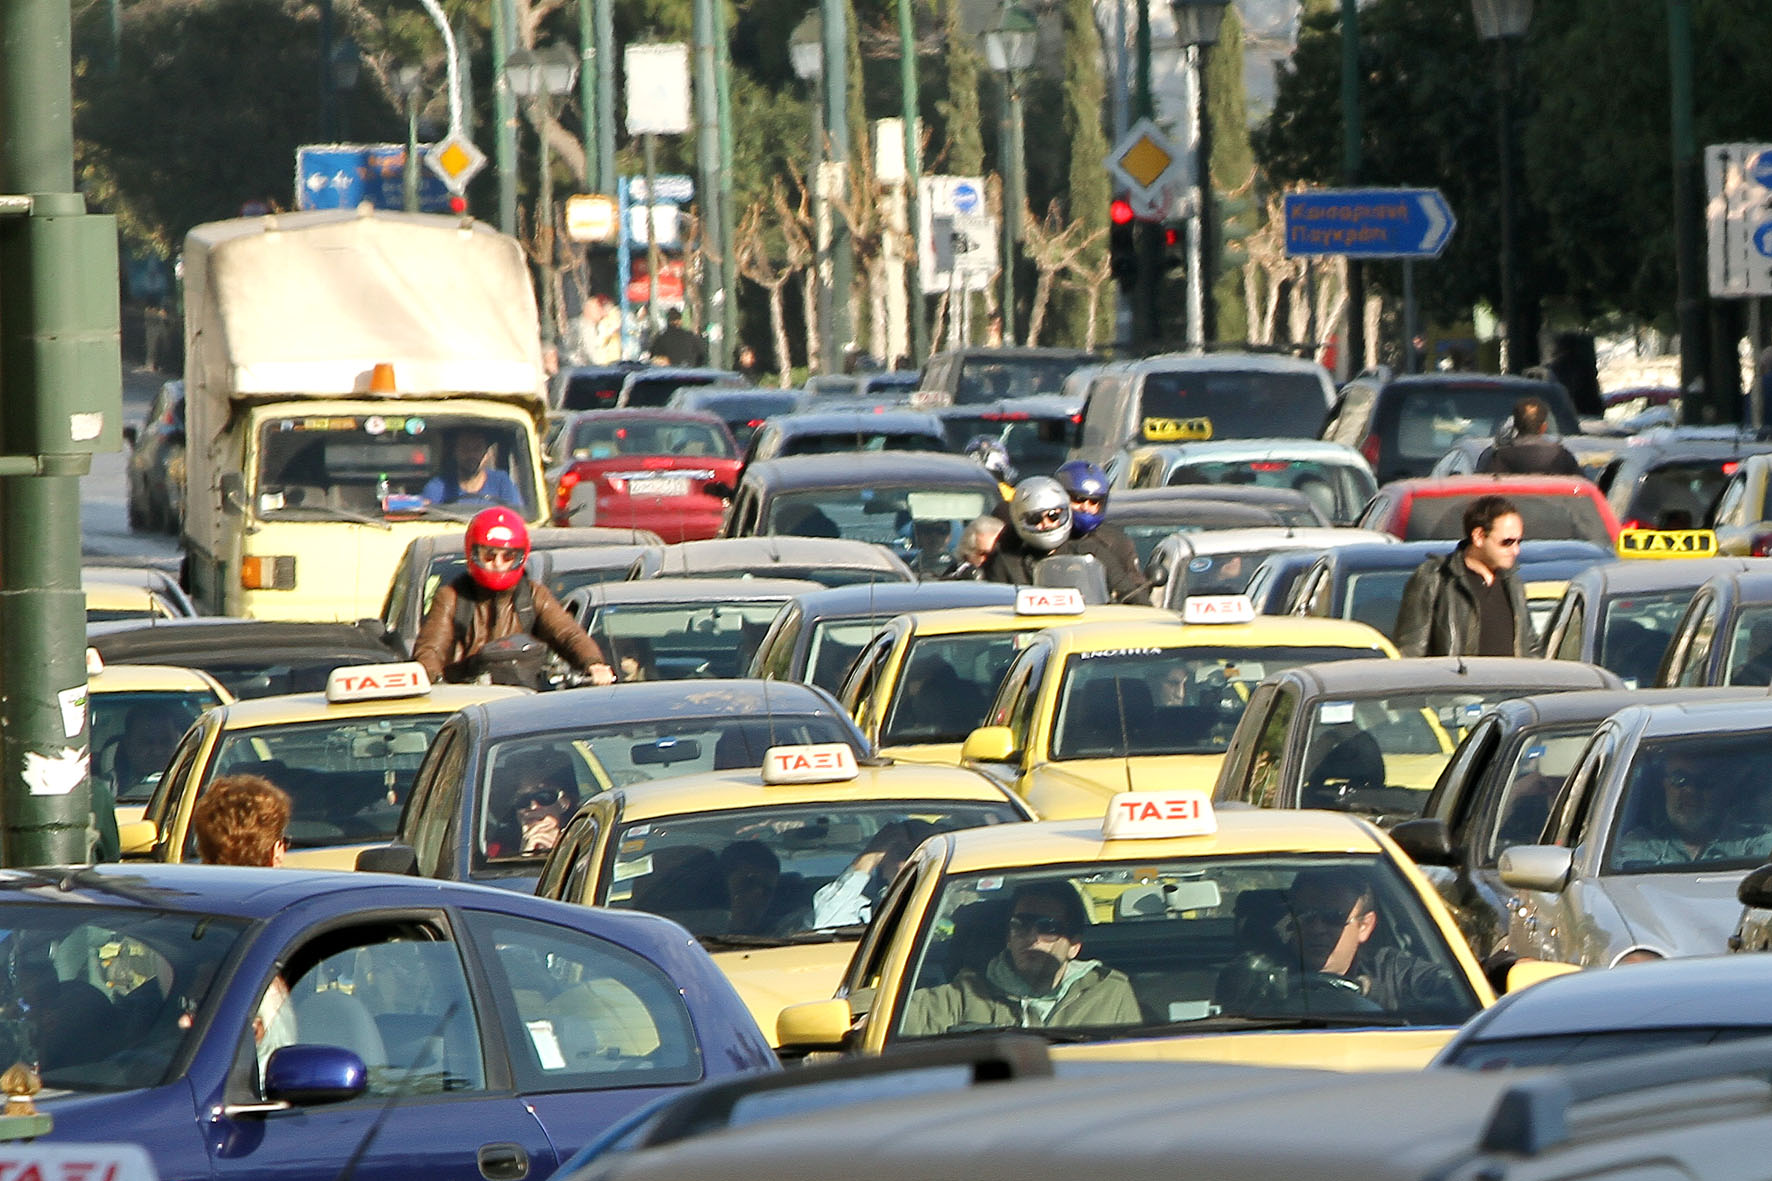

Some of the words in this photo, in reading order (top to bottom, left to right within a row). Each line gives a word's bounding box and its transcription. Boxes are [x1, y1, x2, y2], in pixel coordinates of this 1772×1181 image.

[1628, 532, 1702, 551] TAXI
[1024, 595, 1074, 607] ΤΑΞΙ
[1191, 601, 1243, 614] ΤΑΞΙ
[335, 672, 419, 691] ΤΑΞΙ
[773, 751, 844, 771] ΤΑΞΙ
[1120, 800, 1199, 821] ΤΑΞΙ
